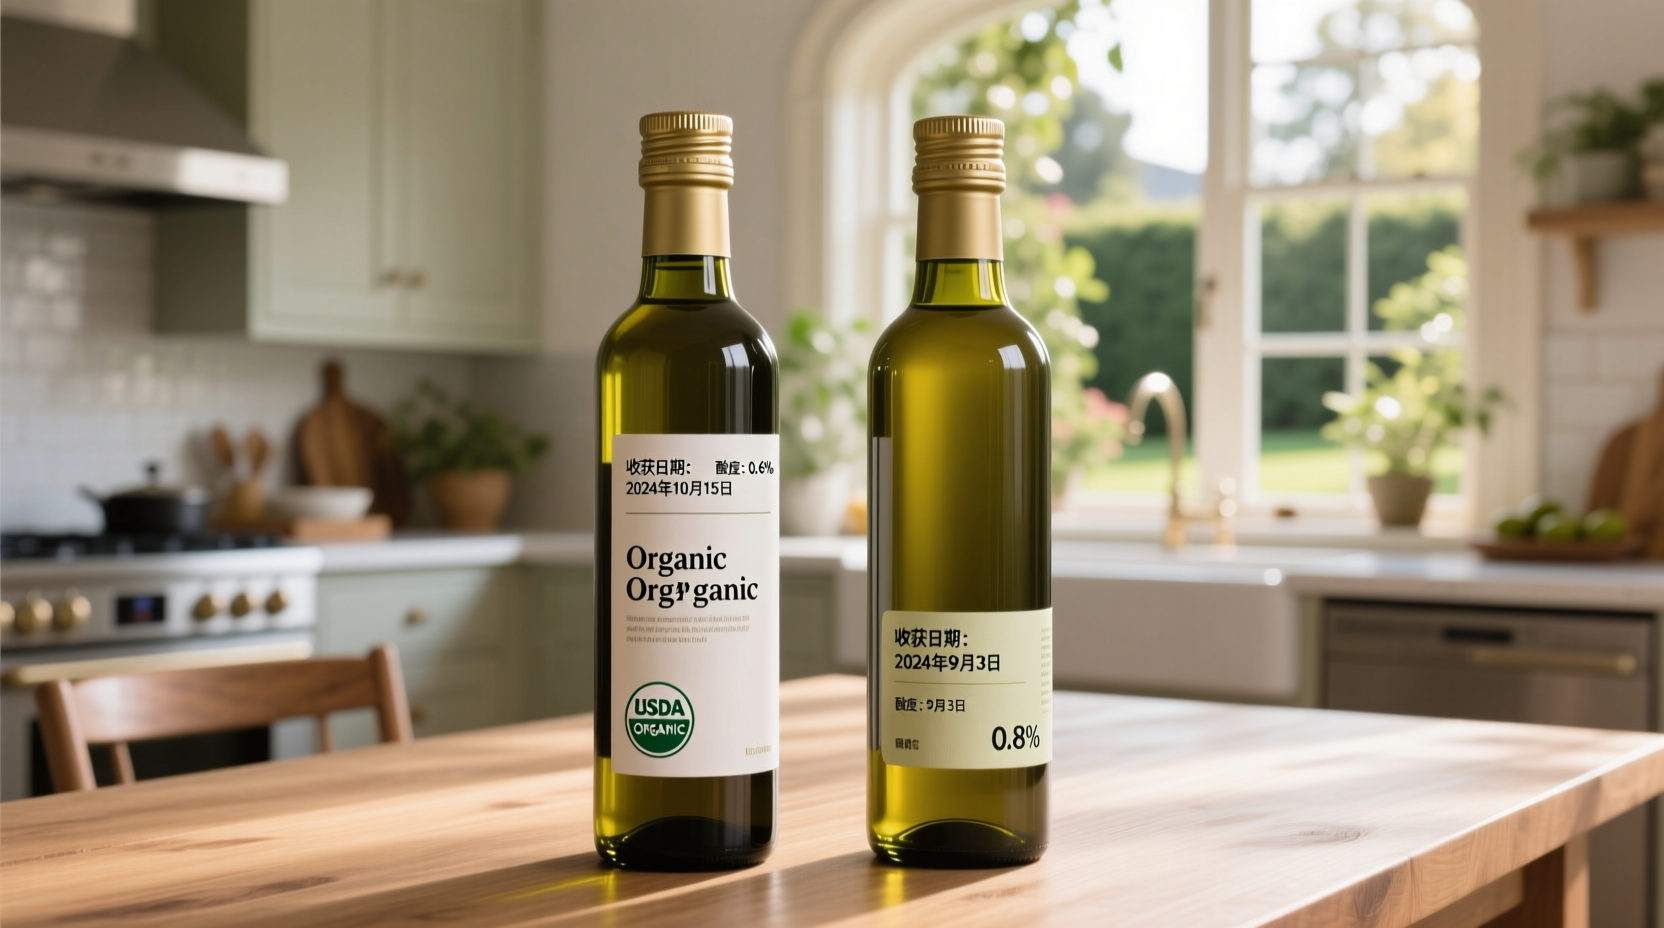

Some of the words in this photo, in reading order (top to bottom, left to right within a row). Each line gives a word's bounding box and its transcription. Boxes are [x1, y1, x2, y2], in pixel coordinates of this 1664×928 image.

[626, 480, 732, 497] 2024年10月15日
[626, 545, 727, 577] Organic
[894, 653, 1000, 672] 2024年9月3日
[634, 698, 685, 717] USDA
[991, 724, 1040, 751] 0.8%
